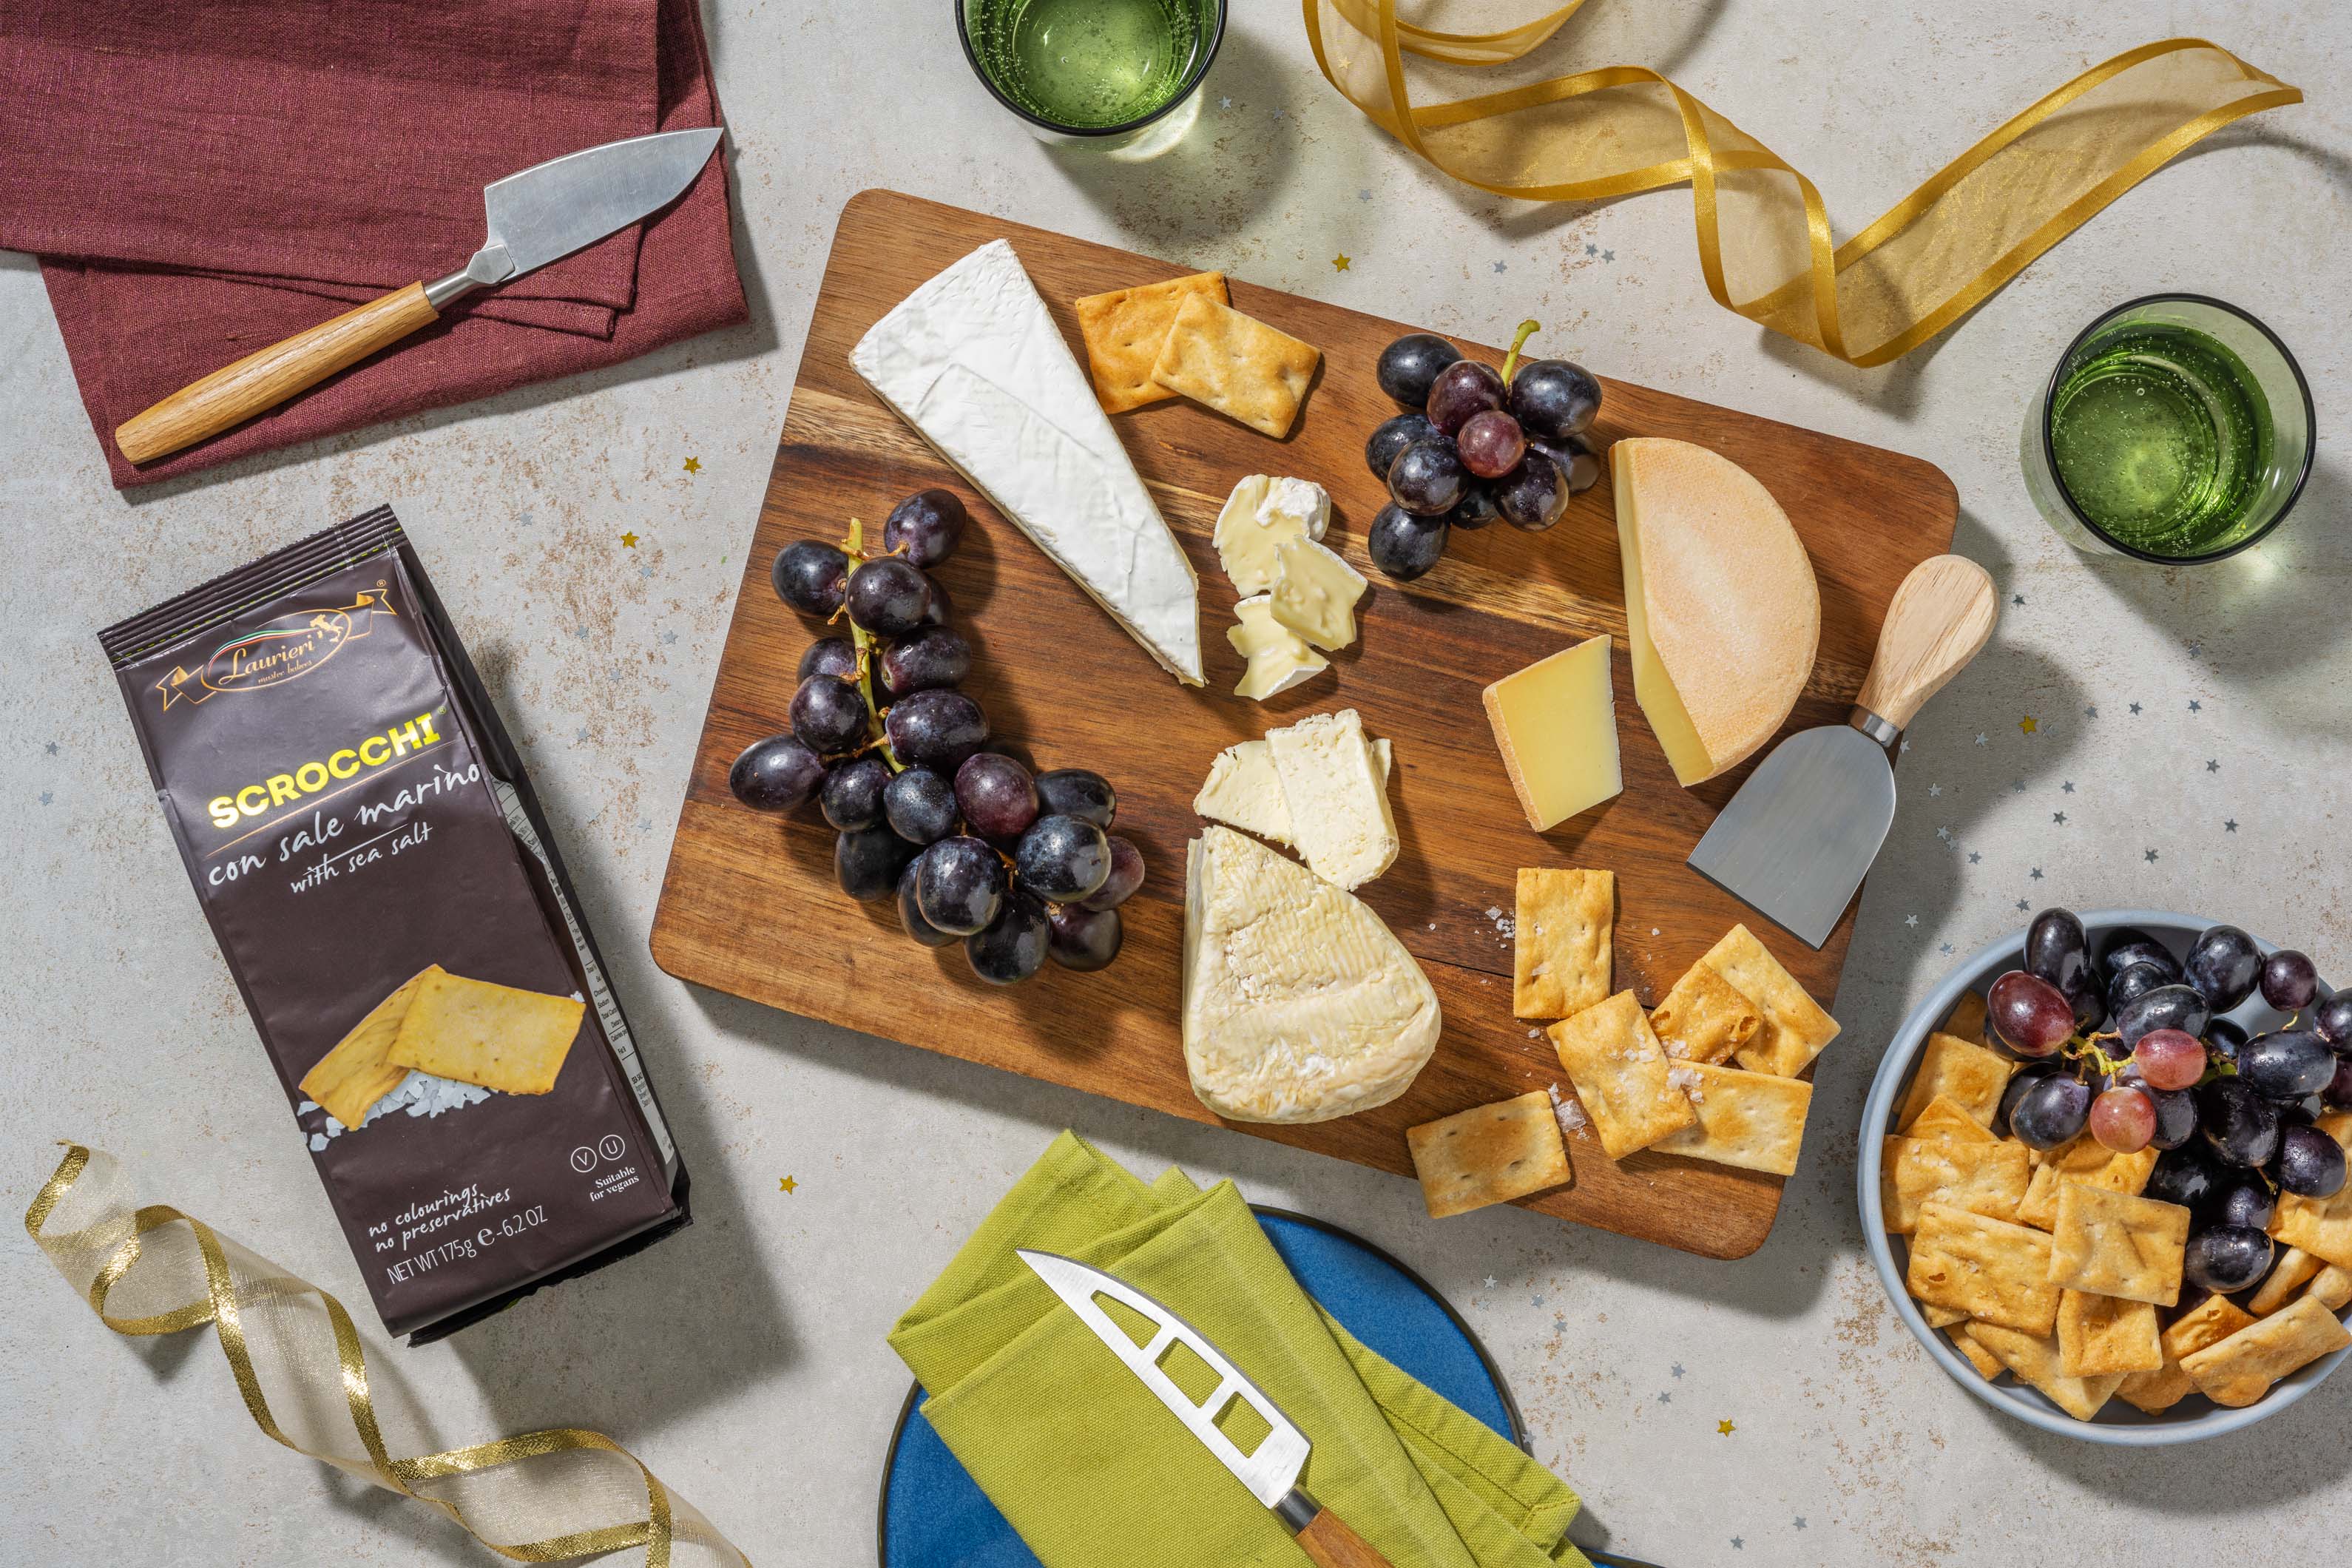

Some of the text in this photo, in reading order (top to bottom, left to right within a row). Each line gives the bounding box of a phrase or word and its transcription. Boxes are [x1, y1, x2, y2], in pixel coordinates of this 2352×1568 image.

[218, 634, 315, 685] Laurieri
[258, 660, 312, 683] master bakers
[208, 712, 441, 829] SCROCCHI
[209, 763, 480, 885] con sale marino
[290, 822, 433, 893] with sea salt
[589, 1175, 639, 1202] for vegans
[595, 1166, 635, 1188] Suitable
[368, 1183, 477, 1237] no colourings
[376, 1188, 510, 1252] no preservatives
[387, 1259, 415, 1284] NET
[414, 1249, 439, 1272] WT
[438, 1239, 477, 1263] 175g
[526, 1206, 548, 1226] OZ
